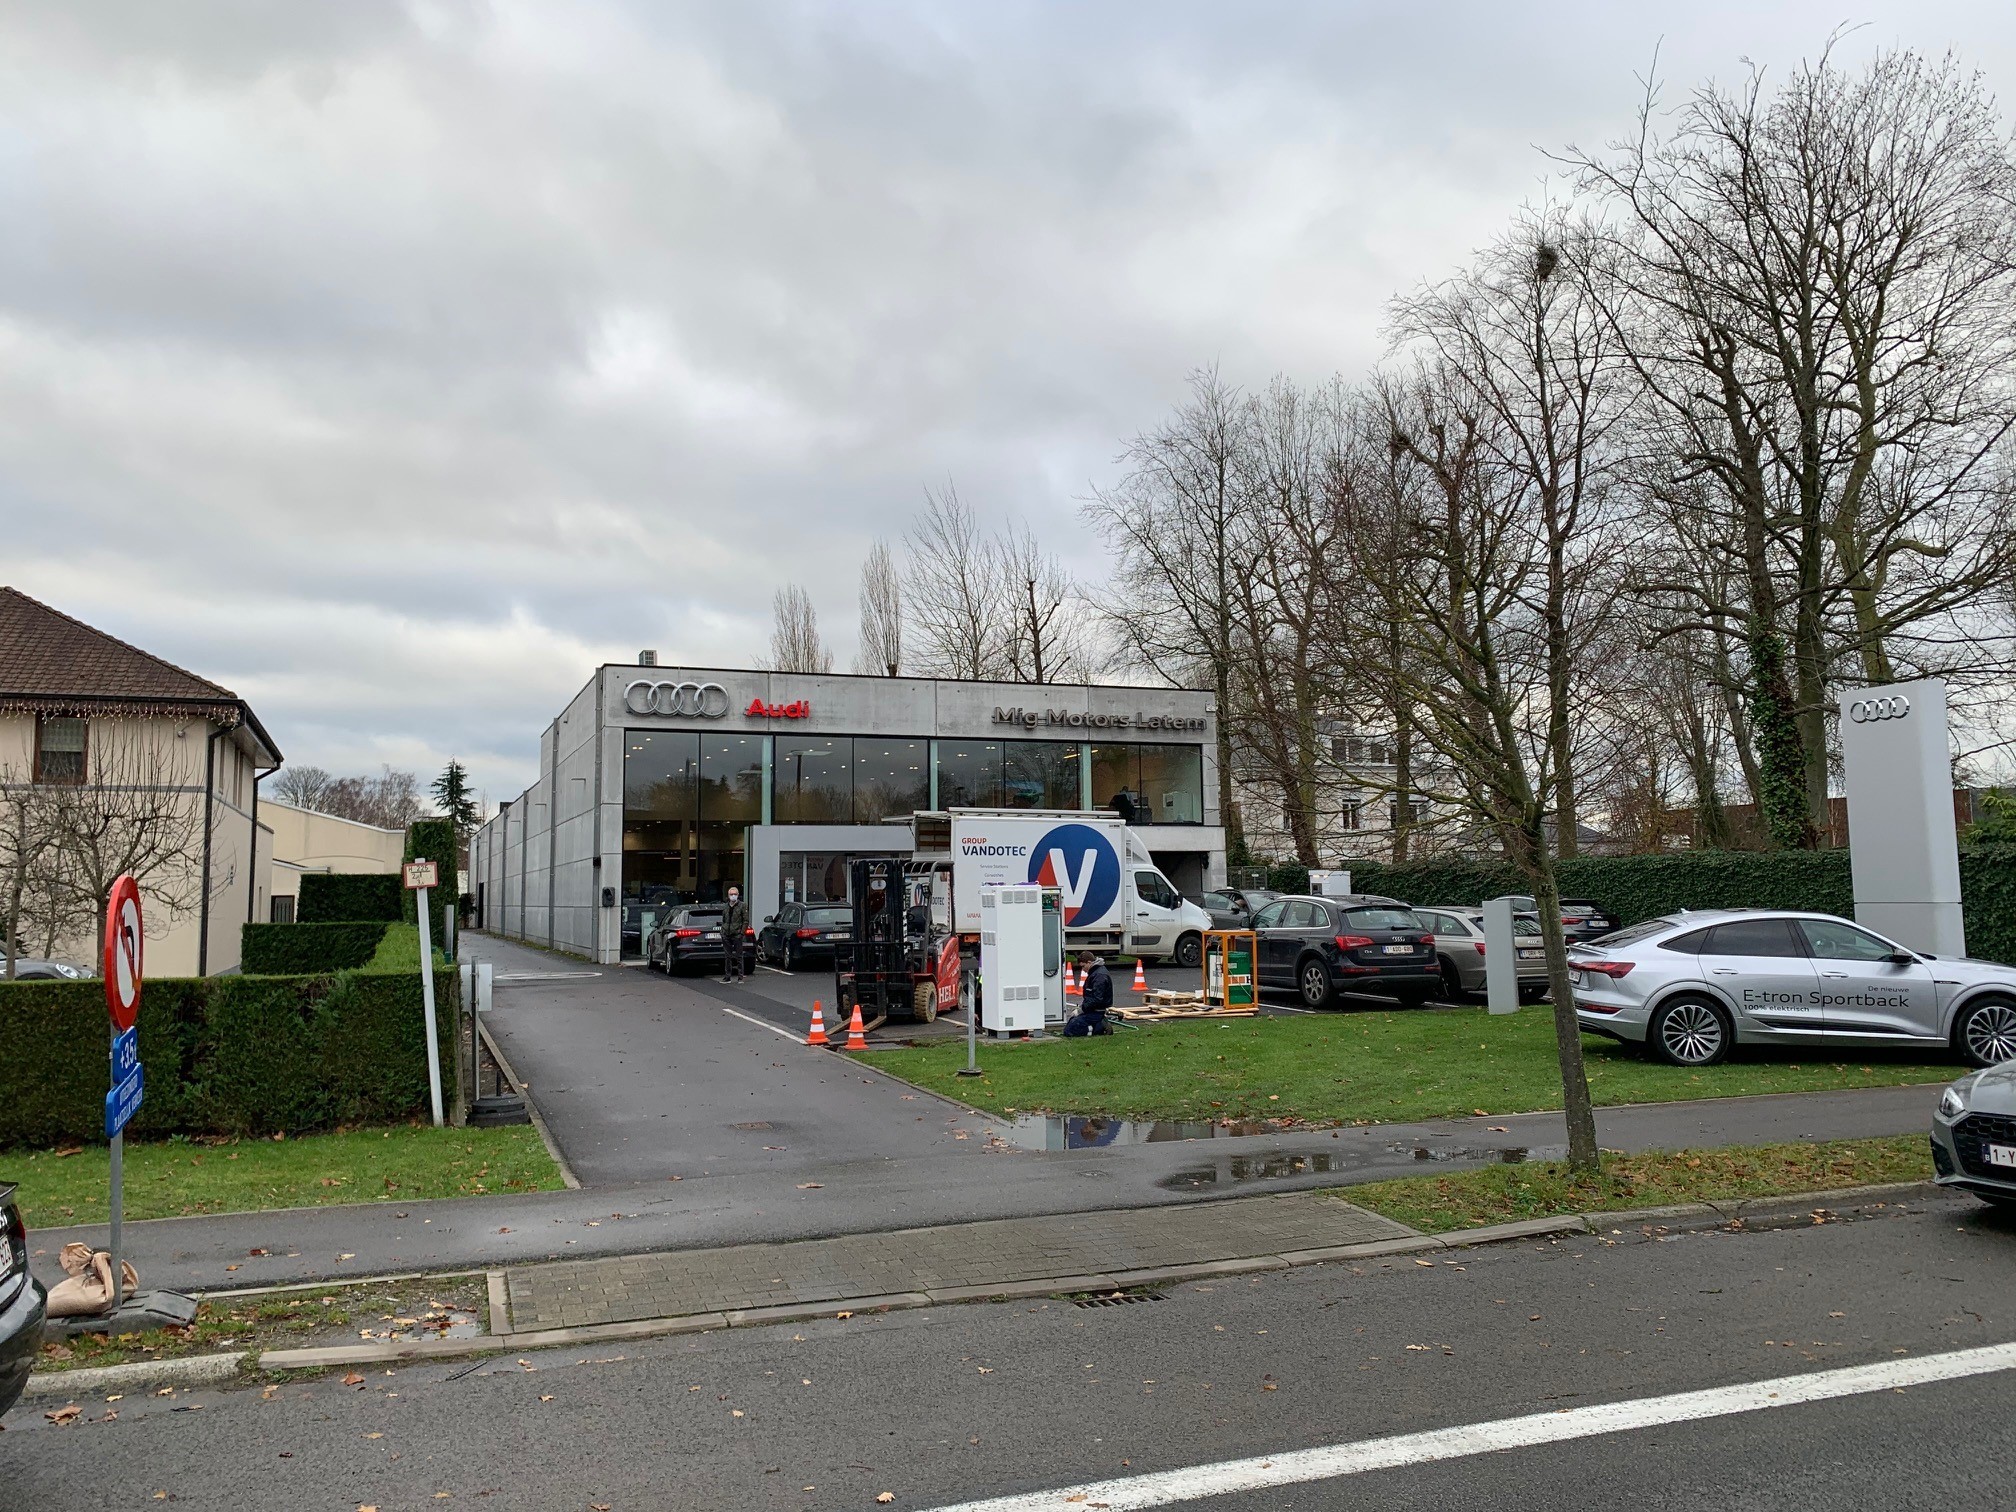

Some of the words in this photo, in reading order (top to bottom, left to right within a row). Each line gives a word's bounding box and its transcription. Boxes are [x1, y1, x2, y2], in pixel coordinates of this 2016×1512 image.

[746, 698, 810, 719] Audi
[993, 707, 1038, 729] Mig
[1047, 709, 1130, 728] Motors
[1136, 712, 1207, 730] Latem
[961, 837, 987, 845] GROUP
[962, 845, 1027, 856] VANDOTEC
[1743, 989, 1803, 1003] E-tron
[1809, 991, 1910, 1007] Sportback
